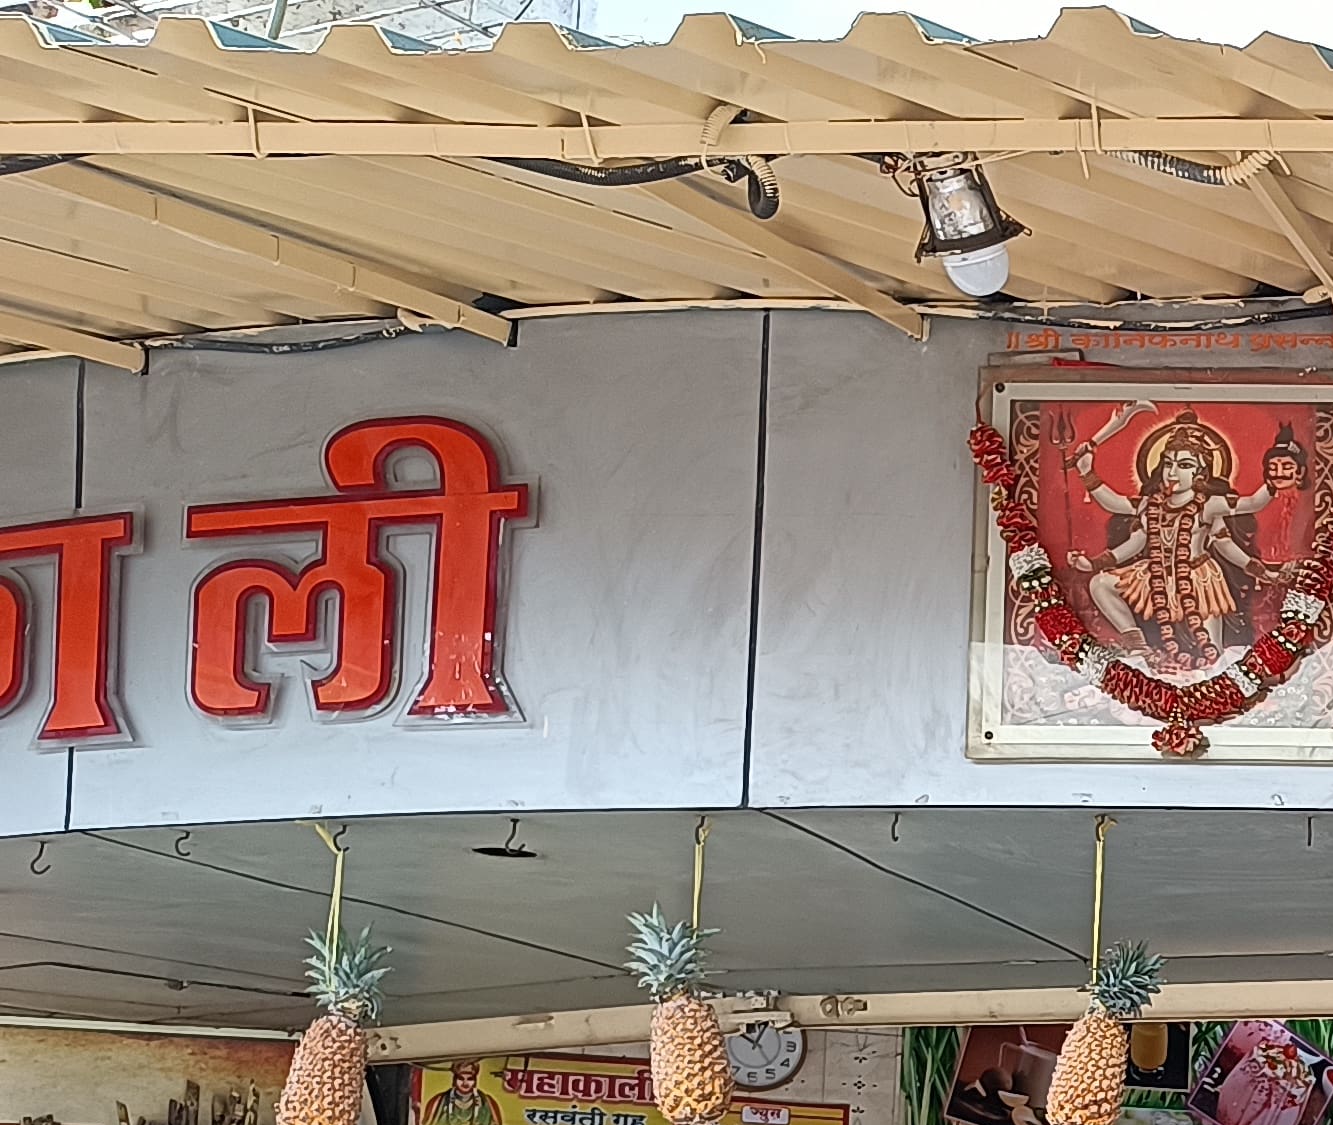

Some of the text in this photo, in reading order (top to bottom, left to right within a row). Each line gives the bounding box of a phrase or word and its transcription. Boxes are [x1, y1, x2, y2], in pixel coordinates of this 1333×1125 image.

[1025, 329, 1062, 350] श्री
[787, 1041, 797, 1053] 3
[780, 1058, 790, 1068] 4
[747, 1072, 758, 1083] 6
[765, 1068, 776, 1080] 5
[525, 1105, 606, 1125] रसवंती
[751, 1107, 782, 1122] ज्युस
